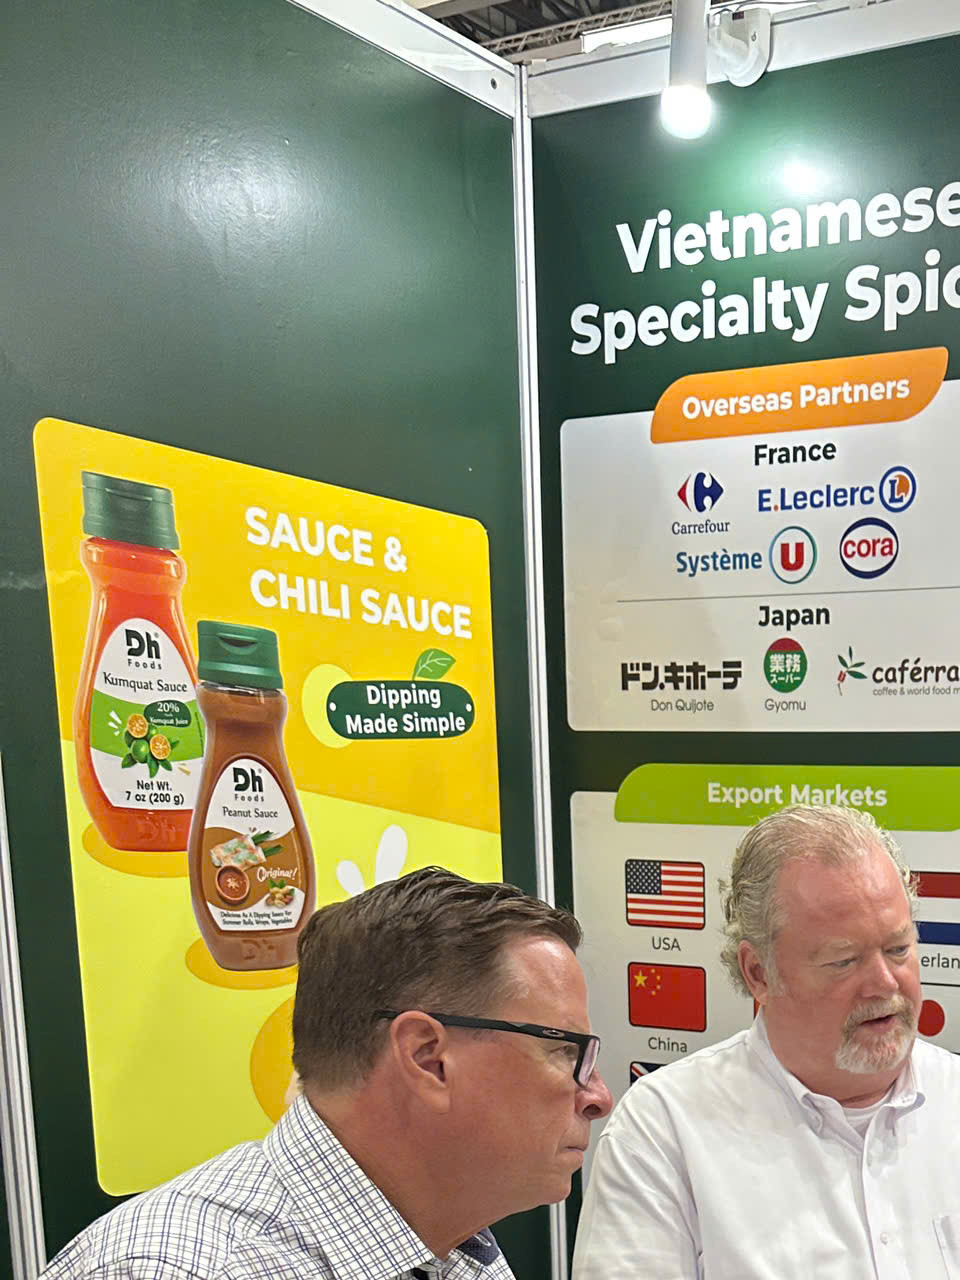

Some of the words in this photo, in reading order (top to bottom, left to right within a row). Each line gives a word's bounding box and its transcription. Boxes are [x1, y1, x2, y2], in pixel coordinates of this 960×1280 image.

[571, 277, 829, 364] Specialty
[682, 388, 792, 419] Overseas
[800, 377, 910, 409] Partners
[754, 441, 836, 466] France
[758, 483, 874, 512] E.Leclerc
[672, 519, 730, 536] Carrefour
[246, 507, 373, 568] SAUCE
[384, 537, 407, 573] &
[843, 535, 895, 559] cora
[676, 548, 762, 576] Système
[251, 570, 350, 619] CHILI
[362, 589, 472, 639] SAUCE
[758, 606, 830, 631] Japan
[126, 629, 160, 659] Dh
[128, 659, 162, 670] Foods
[769, 654, 801, 673] 業務
[103, 672, 153, 692] Kumquat
[157, 679, 187, 692] Sauce
[770, 674, 801, 684] スーパー
[368, 684, 441, 713] Dipping
[873, 687, 898, 696] coffee
[899, 686, 905, 695] &
[907, 686, 930, 695] world
[932, 686, 950, 695] food
[157, 702, 179, 713] 20%
[651, 699, 672, 712] Don
[676, 699, 714, 713] Quijote
[765, 699, 806, 712] Gyomu
[346, 715, 398, 735] Made
[403, 712, 466, 736] Simple
[137, 780, 154, 790] Net
[156, 781, 172, 791] Wt.
[233, 767, 263, 792] Dh
[126, 791, 131, 800] 7
[135, 794, 145, 802] oz
[150, 793, 170, 805] (200
[174, 794, 184, 805] g)
[235, 794, 264, 802] Foods
[708, 783, 783, 806] Export
[791, 784, 887, 807] Markets
[223, 806, 251, 818] Peanut
[255, 809, 278, 818] Sauce
[652, 937, 681, 952] USA
[648, 1037, 687, 1053] China
